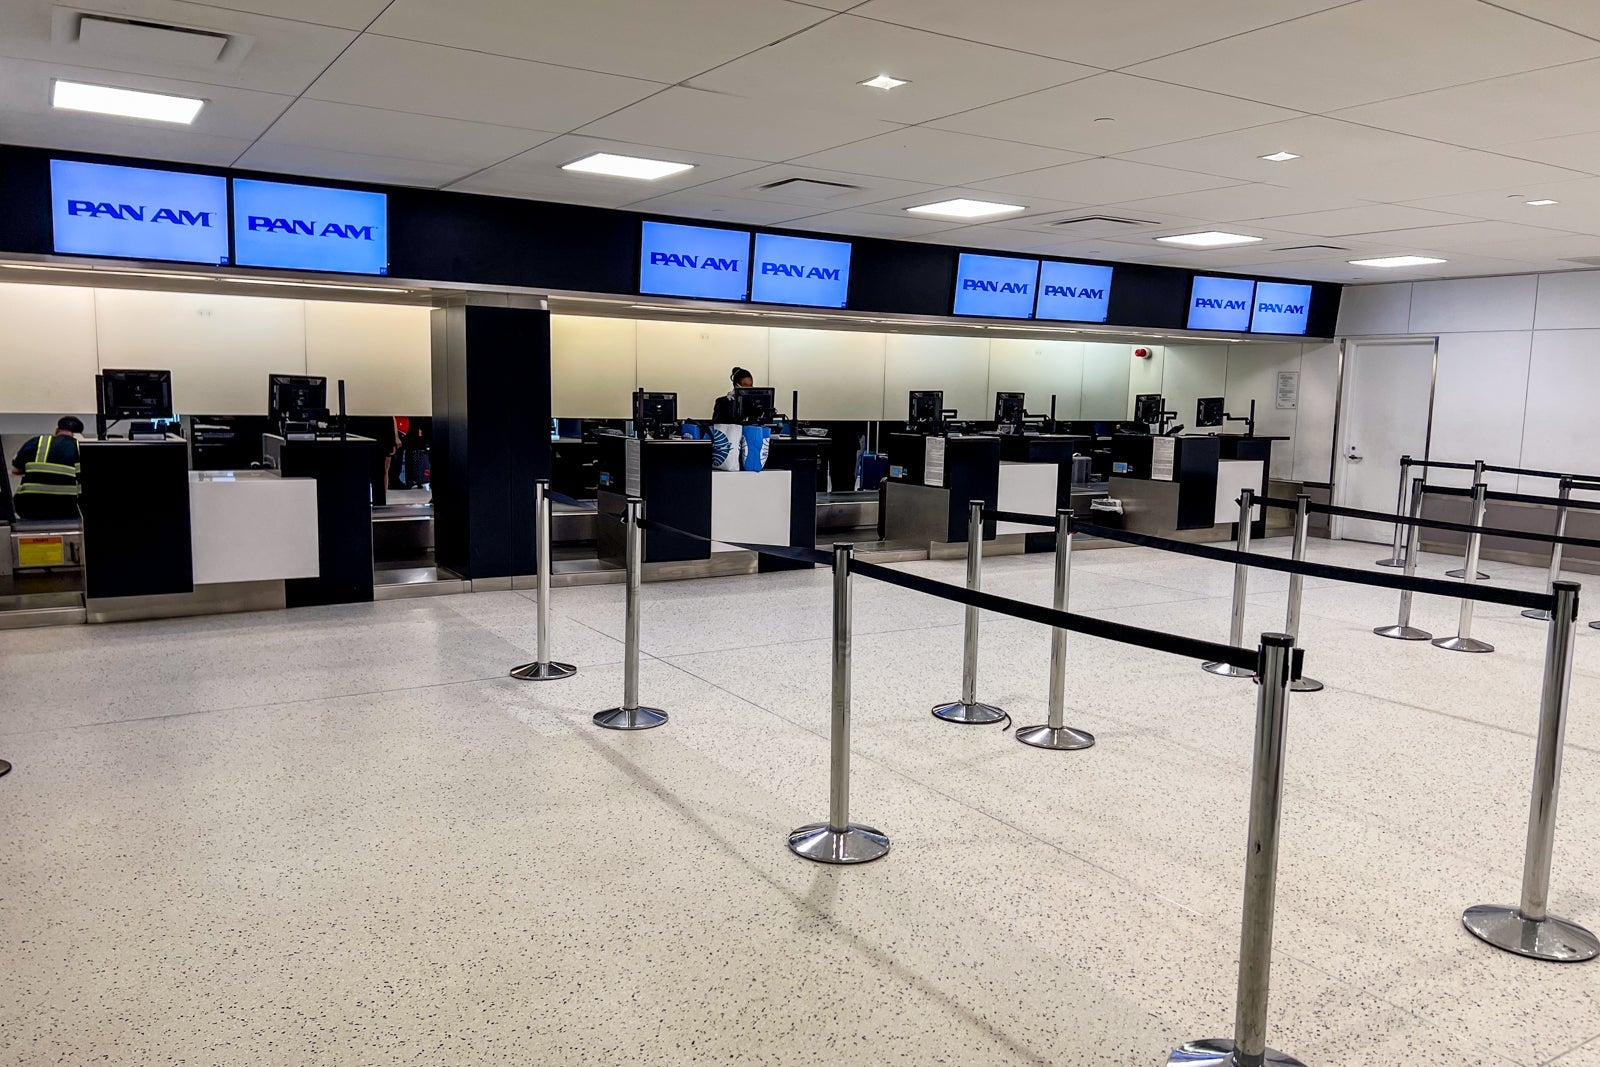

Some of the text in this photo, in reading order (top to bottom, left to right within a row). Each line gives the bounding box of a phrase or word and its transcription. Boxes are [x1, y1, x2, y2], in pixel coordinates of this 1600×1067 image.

[68, 200, 214, 228] PAN AM
[248, 215, 375, 241] PAN AM
[650, 252, 739, 272] PAN AM
[762, 262, 842, 281] PAN AM
[963, 279, 1030, 295] PAN AM
[1045, 285, 1105, 300] PAN AM
[1195, 297, 1246, 311] PAN AM
[1258, 302, 1304, 315] PAN AM
